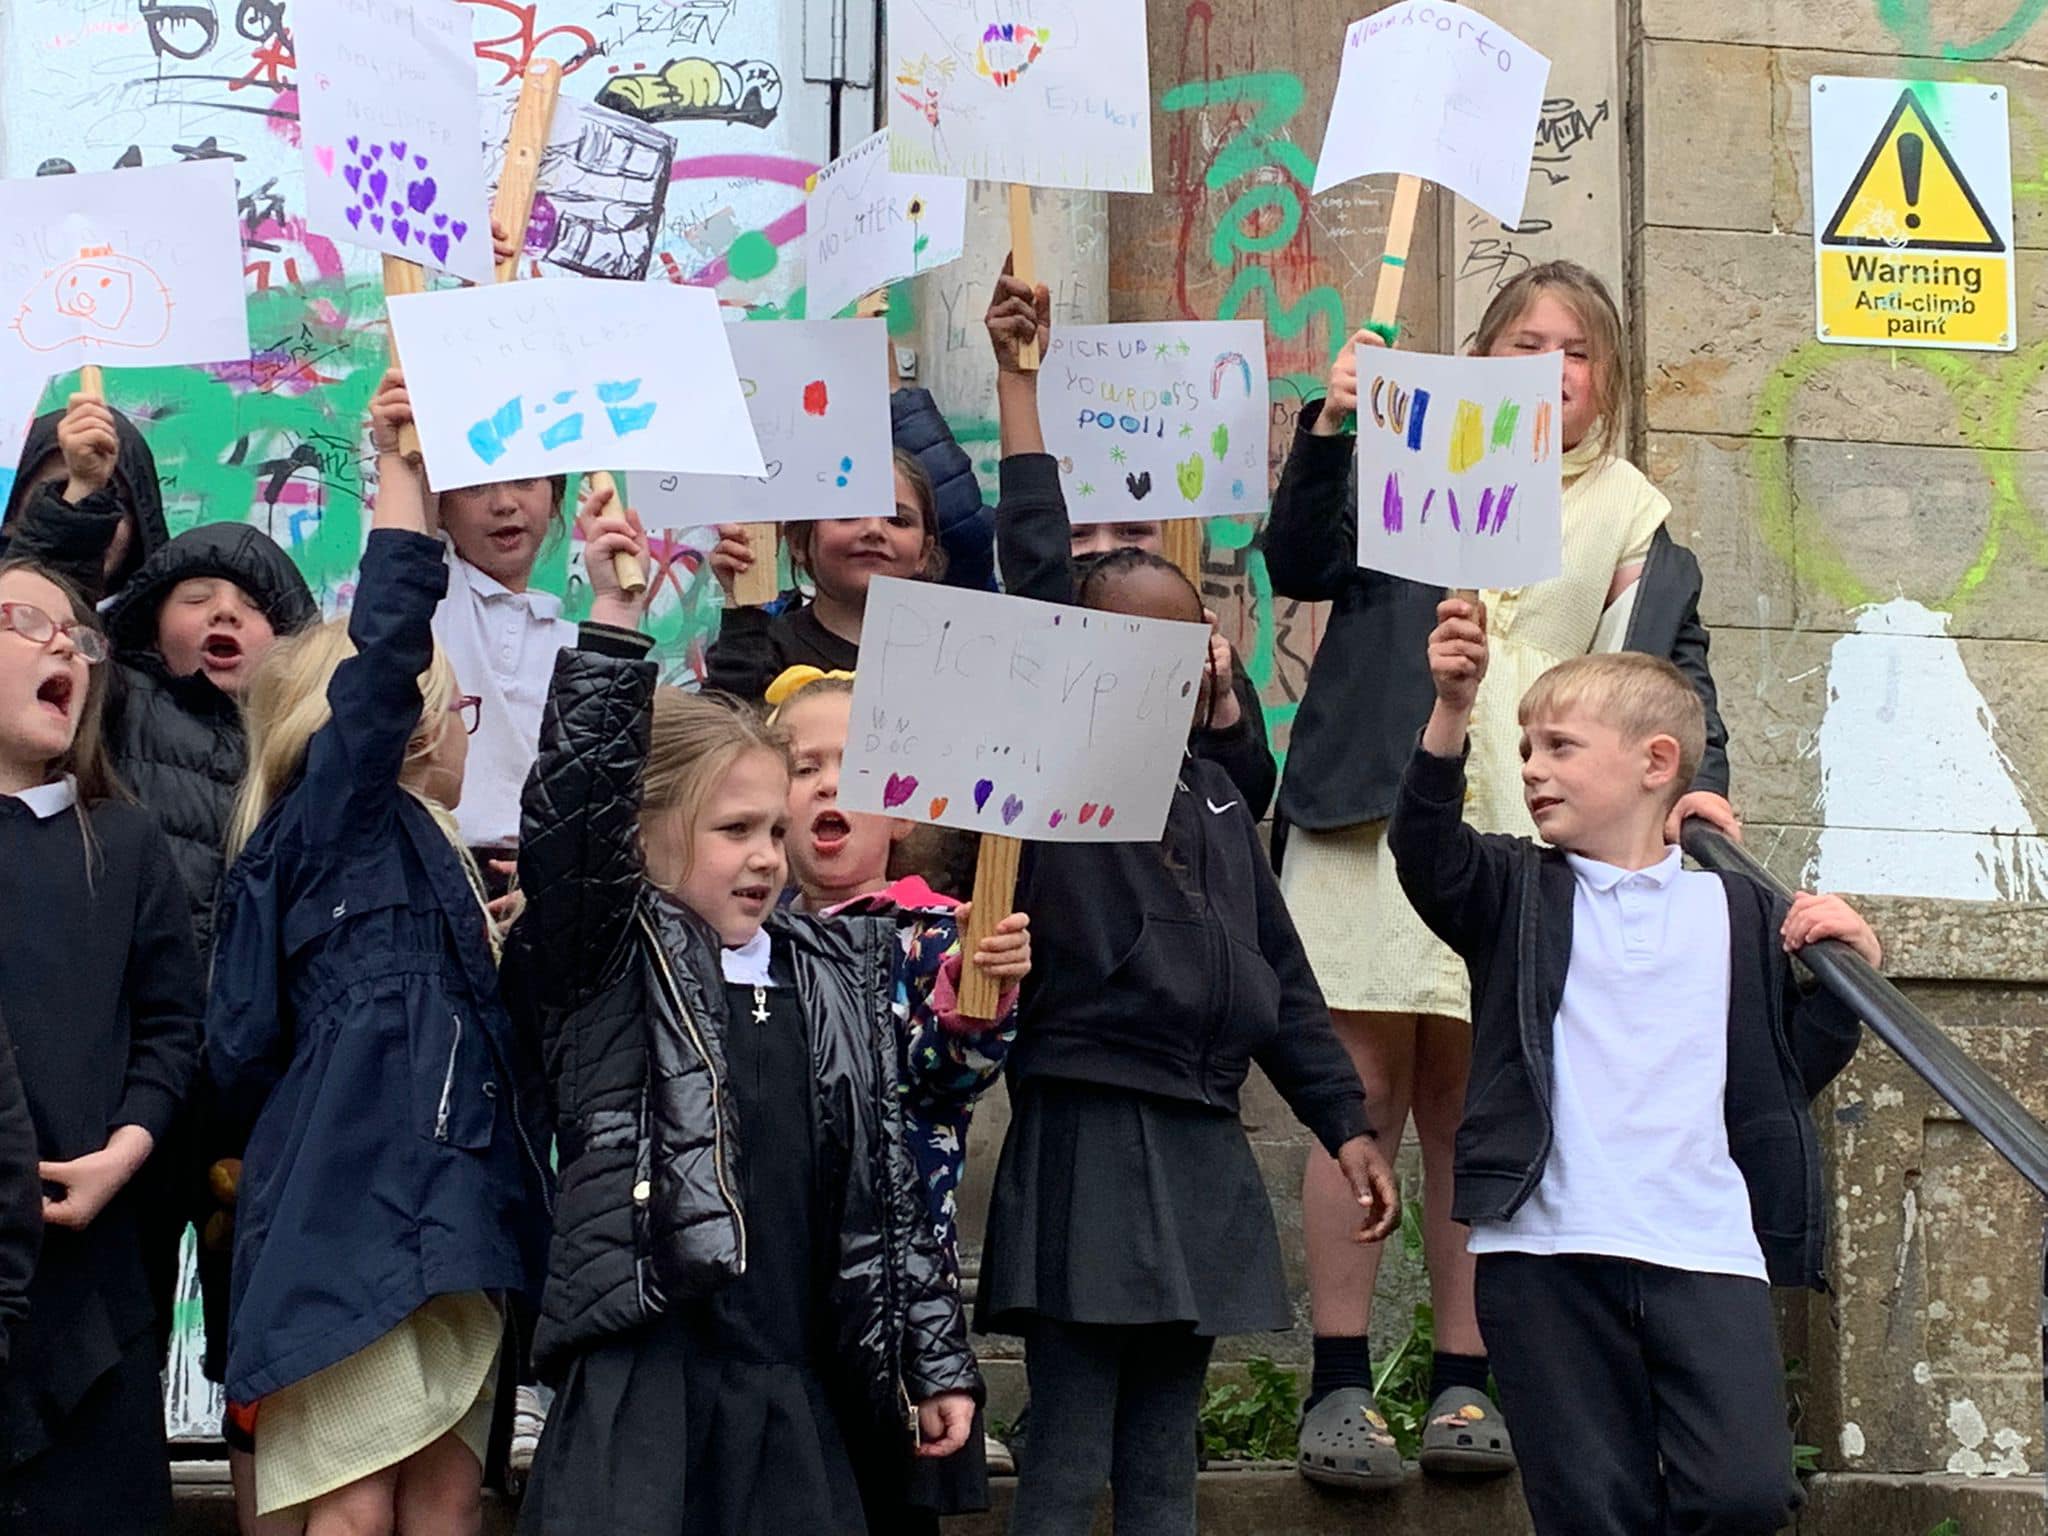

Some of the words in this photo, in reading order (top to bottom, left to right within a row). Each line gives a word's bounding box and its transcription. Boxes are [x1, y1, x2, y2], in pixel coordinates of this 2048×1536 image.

[818, 232, 840, 265] NO
[1846, 254, 1983, 293] Warning
[1855, 290, 1977, 315] Anti-climb
[1887, 313, 1947, 337] paint
[1052, 338, 1109, 359] PICK
[1118, 339, 1149, 359] UP
[1065, 365, 1137, 412] YOUR
[880, 603, 1042, 698] PICK
